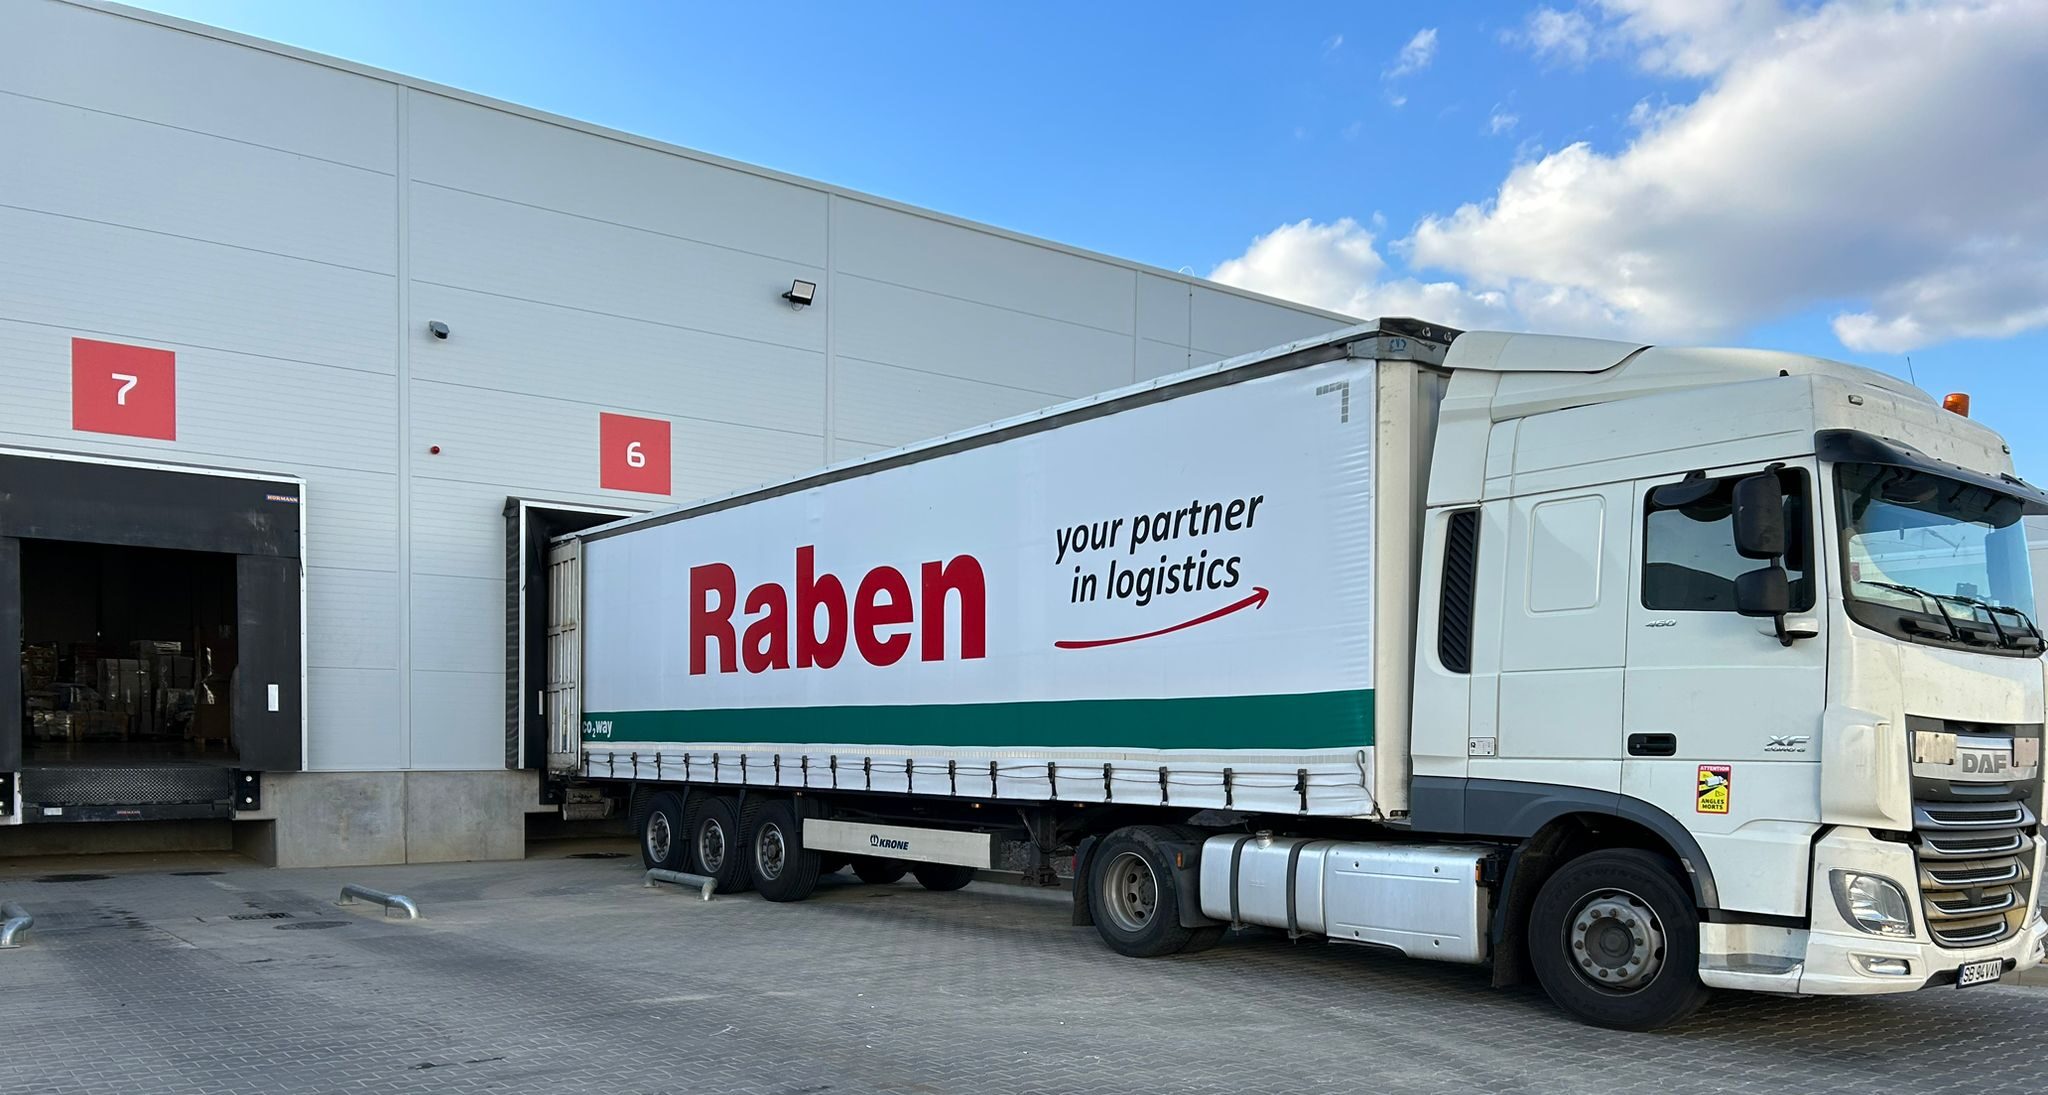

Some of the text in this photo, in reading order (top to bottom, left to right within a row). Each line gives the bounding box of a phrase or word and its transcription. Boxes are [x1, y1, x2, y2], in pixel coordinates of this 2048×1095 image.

[111, 372, 138, 405] 7
[626, 441, 646, 468] 6
[1055, 495, 1264, 565] your partner
[1070, 549, 1241, 606] in logistics
[689, 544, 986, 675] Raben
[1766, 735, 1810, 746] XF
[1962, 753, 2007, 774] DAF
[879, 838, 909, 850] KRONE
[1963, 966, 1975, 983] SB
